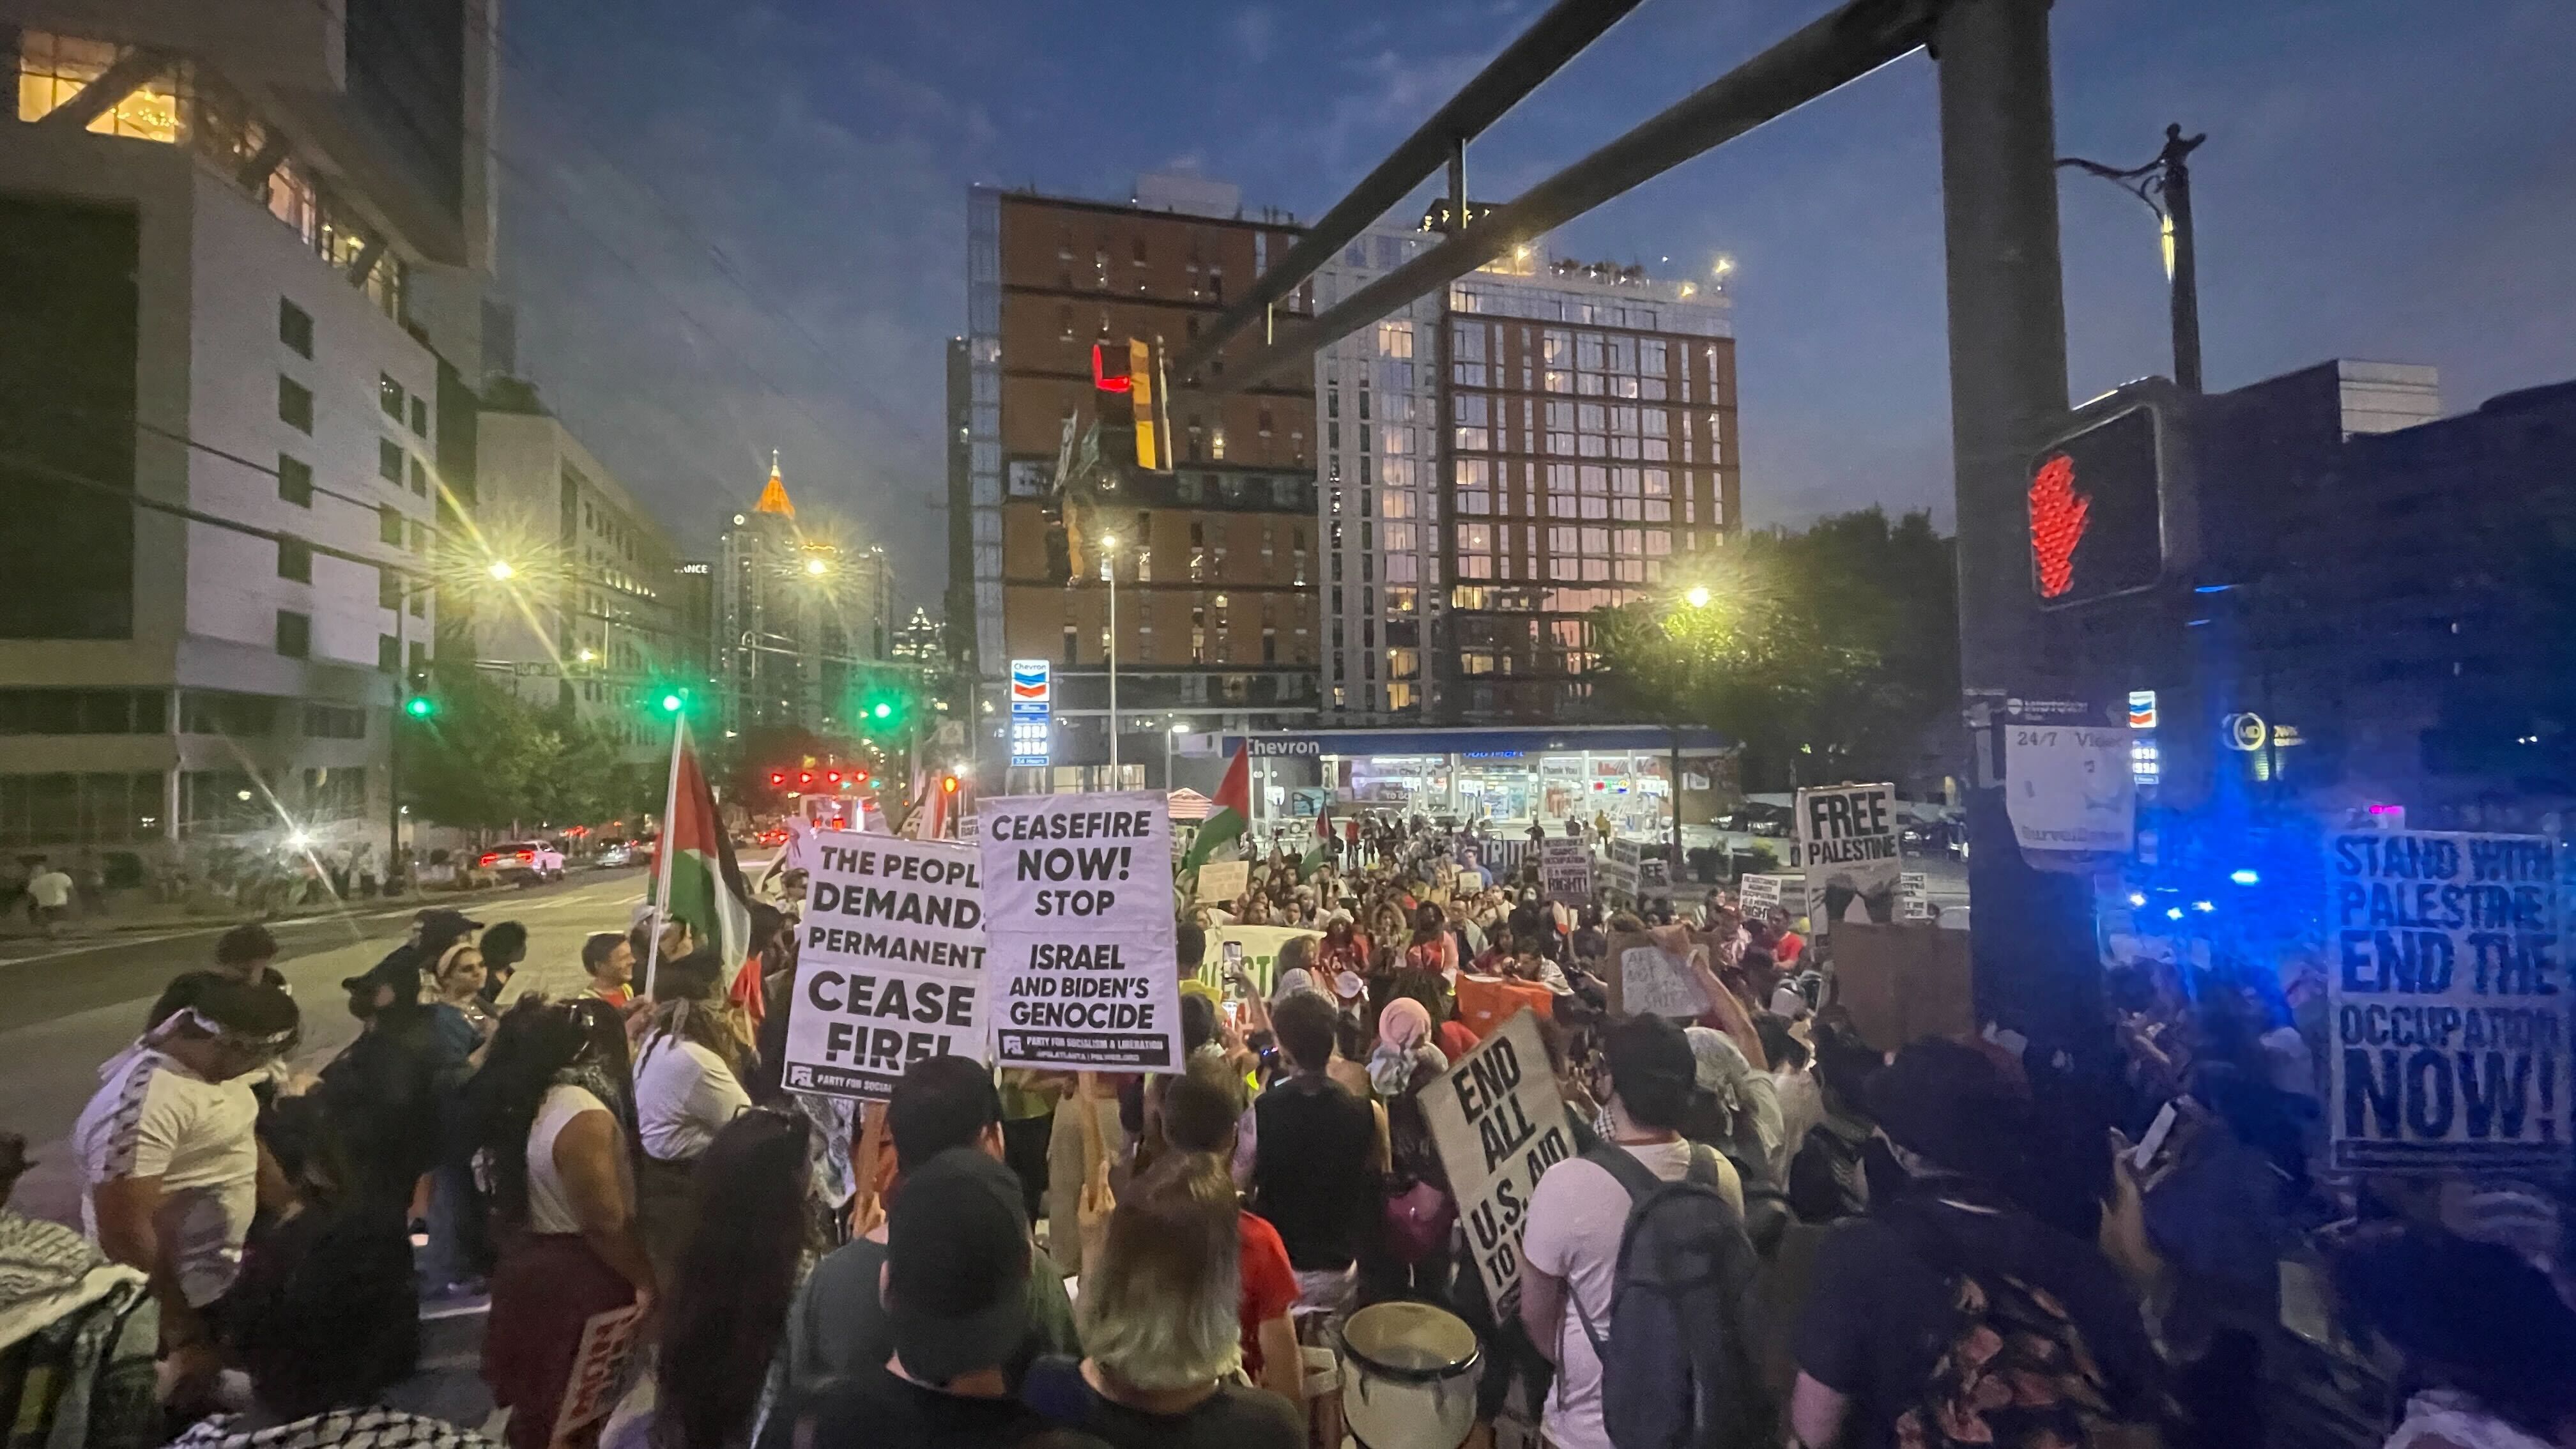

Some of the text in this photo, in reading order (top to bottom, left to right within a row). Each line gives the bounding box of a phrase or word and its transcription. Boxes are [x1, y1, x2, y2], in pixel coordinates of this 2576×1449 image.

[2018, 731, 2057, 747] 24/7
[992, 811, 1151, 842] CEASEFIRE
[1809, 791, 1889, 840] FREE
[821, 845, 983, 890] THE PEOPL
[1017, 847, 1131, 882] NOW!
[1808, 834, 1897, 866] PALESTINE
[2334, 835, 2460, 880] STAND
[1035, 890, 1115, 916] STOP
[1548, 877, 1587, 891] RIGHT!
[808, 926, 986, 969] PERMANENT
[1030, 944, 1125, 970] ISRAEL
[2341, 929, 2558, 996] END THE
[808, 970, 976, 1027] CEASE
[1009, 977, 1148, 999] AND BIDEN'S
[1009, 1002, 1154, 1029] GENOCIDE
[1027, 1036, 1049, 1046] PARTY
[1052, 1036, 1065, 1047] FOR
[818, 1074, 845, 1087] PARTY
[846, 1078, 862, 1089] FOR
[1452, 1036, 1521, 1125] END
[2343, 1048, 2556, 1138] NOW!
[1478, 1092, 1537, 1174] ALL
[1471, 1179, 1529, 1250] U.S.
[1485, 1241, 1515, 1287] TO
